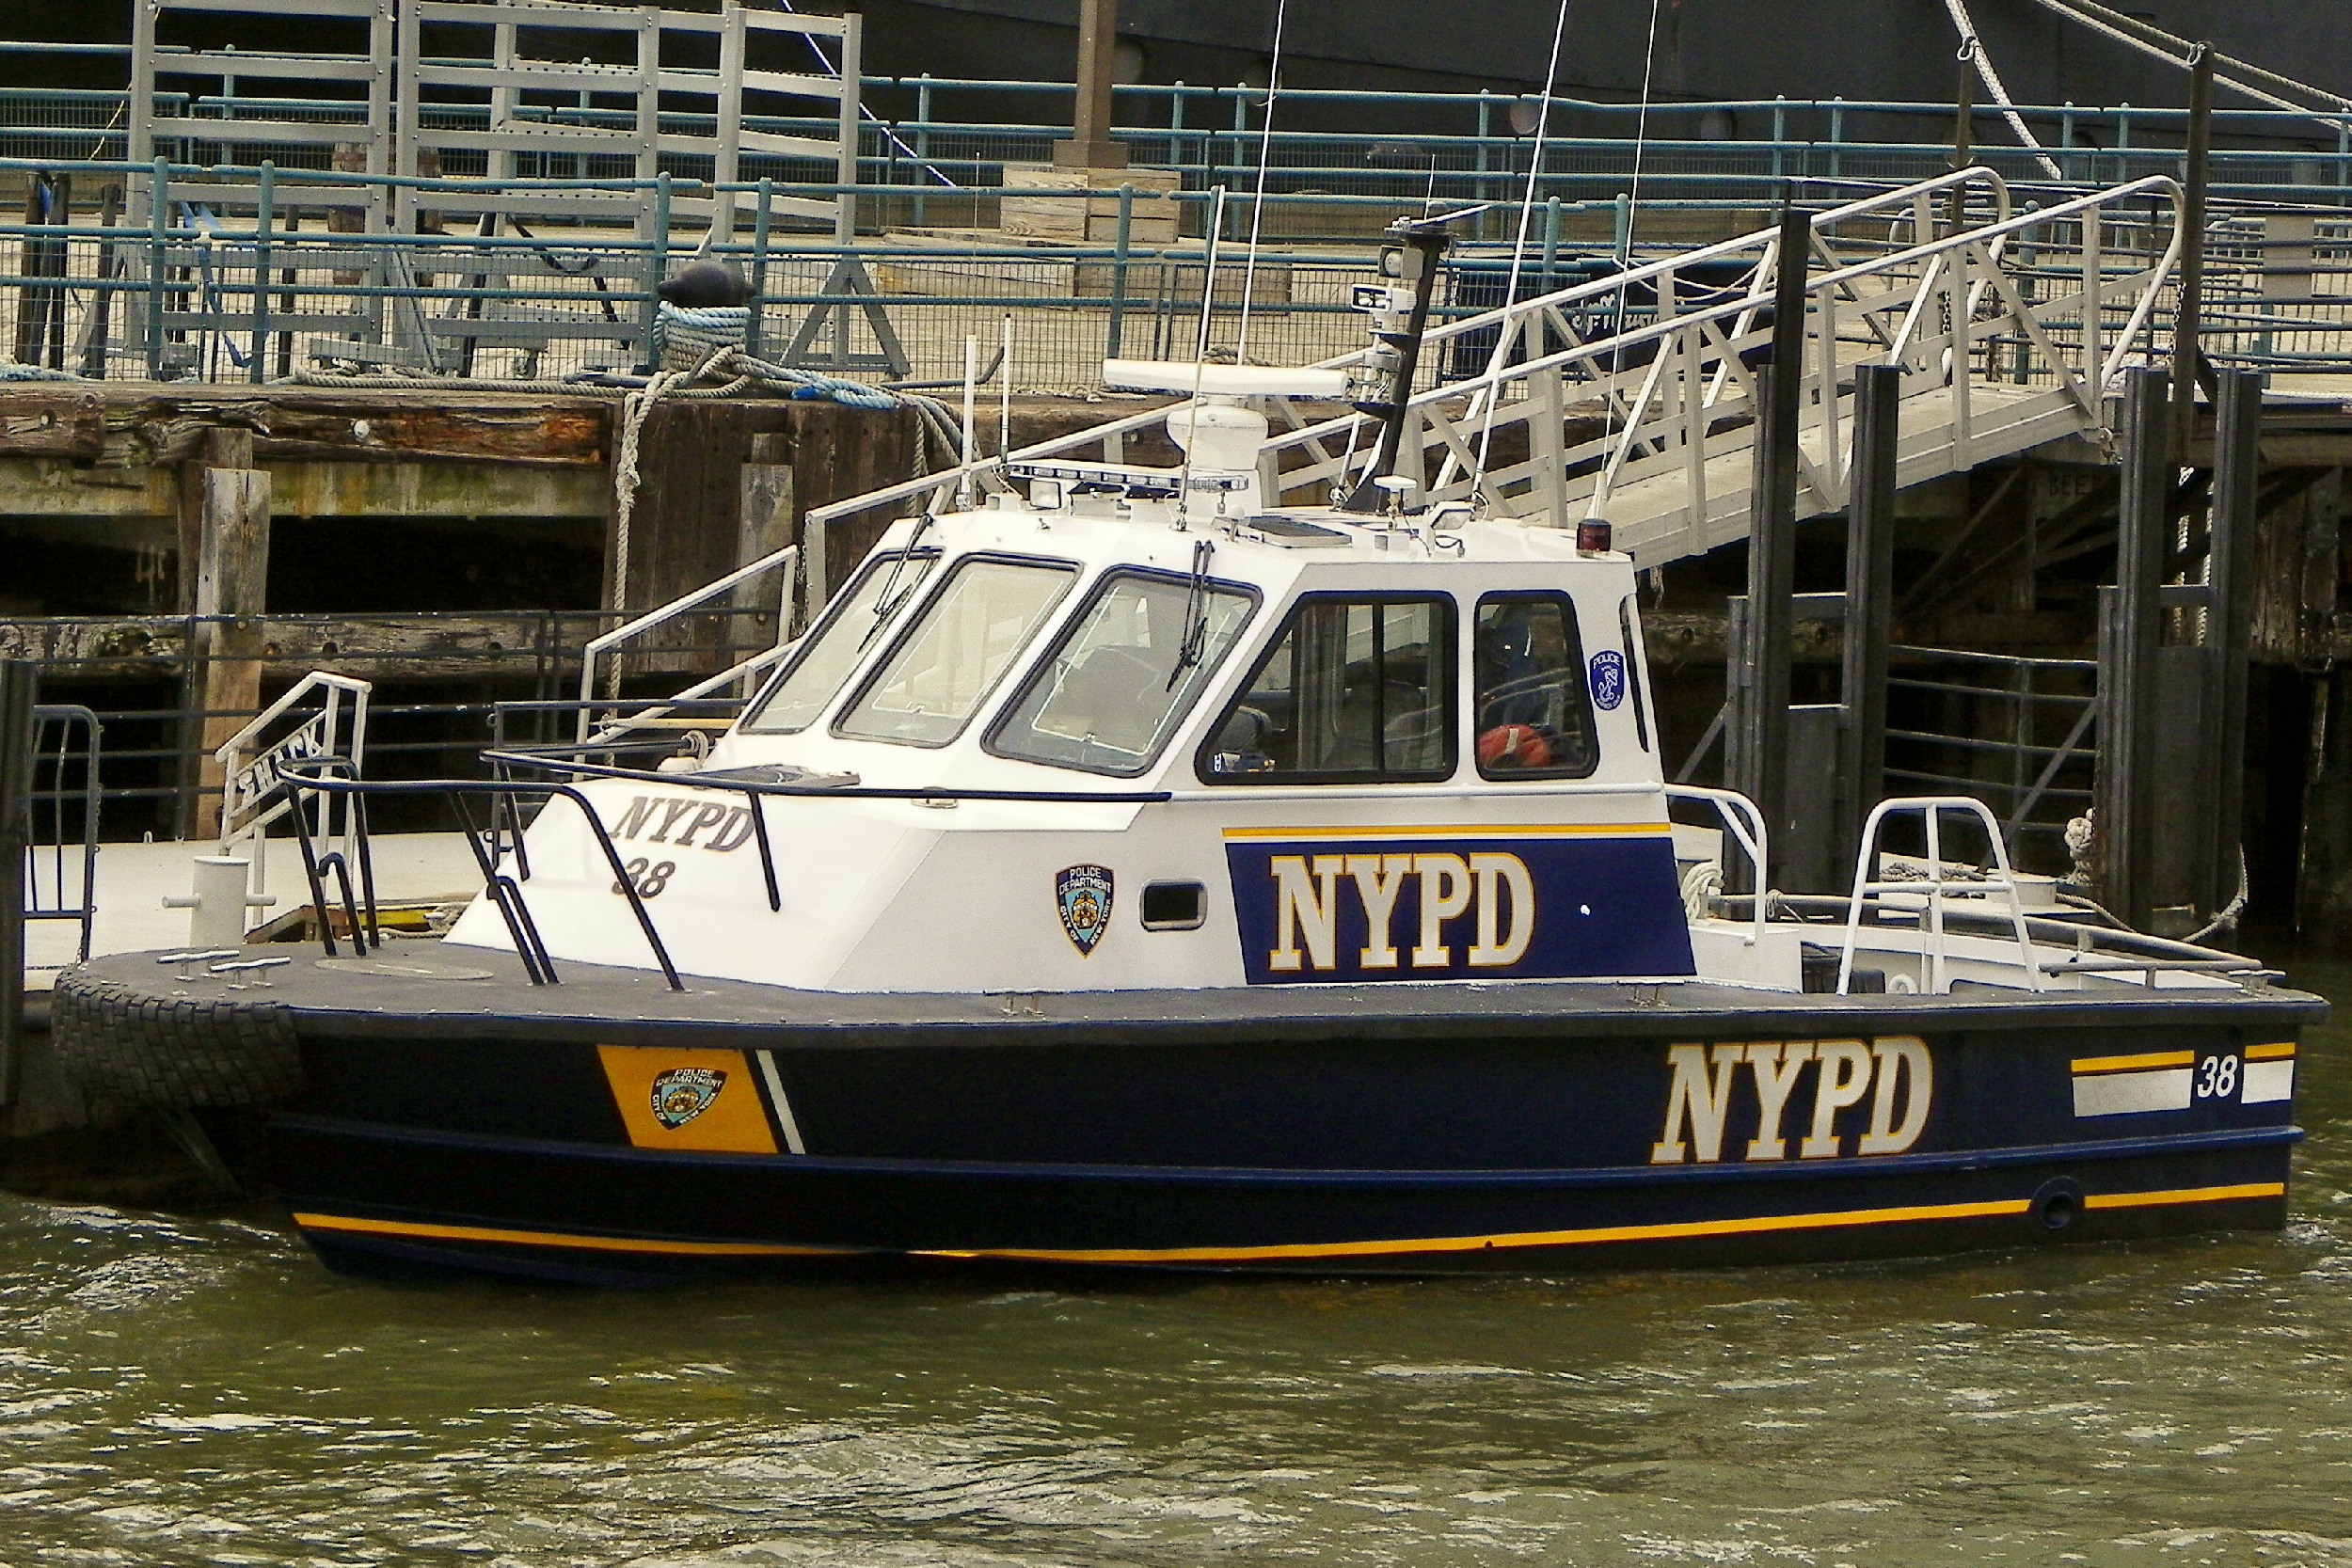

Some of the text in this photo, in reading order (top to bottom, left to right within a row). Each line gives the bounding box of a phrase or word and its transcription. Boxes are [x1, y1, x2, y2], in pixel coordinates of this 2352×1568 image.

[1593, 653, 1620, 670] POLICE
[608, 796, 756, 852] NYPD
[612, 857, 676, 899] 38
[1058, 877, 1111, 895] DEPARTMENT
[1070, 866, 1101, 879] POLICE
[1059, 905, 1080, 942] CITY OF
[1089, 898, 1111, 945] NEW YORK
[1270, 852, 1535, 971] NYPD
[656, 1076, 723, 1087] DEPARTMENT
[674, 1069, 715, 1078] POLICE
[2197, 1054, 2238, 1098] 38
[1650, 1035, 1933, 1164] NYPD
